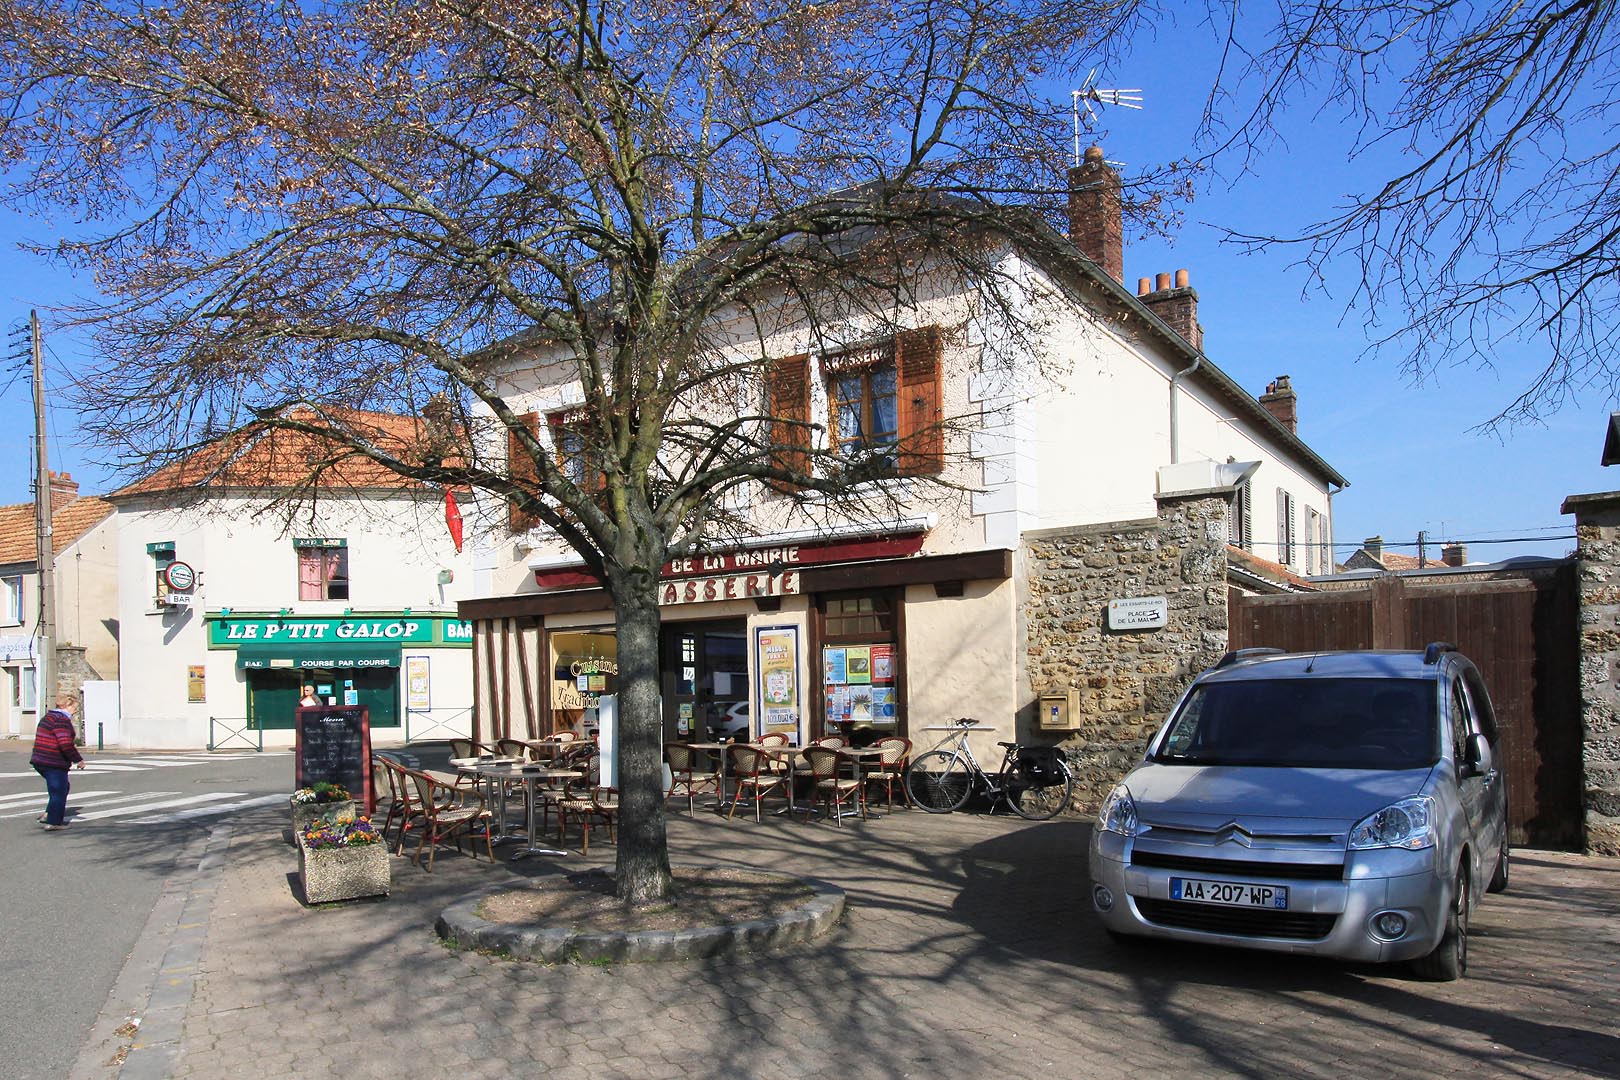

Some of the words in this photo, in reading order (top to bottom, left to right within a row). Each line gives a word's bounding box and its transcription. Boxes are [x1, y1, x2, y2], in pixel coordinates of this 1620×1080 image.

[671, 559, 694, 573] DE
[703, 555, 726, 570] LA
[734, 546, 800, 567] MAIRIE
[664, 571, 796, 602] ASSERIE
[173, 595, 190, 603] BAR
[227, 623, 258, 640] LE
[263, 623, 329, 640] P'TIT
[336, 622, 419, 639] GALOP
[447, 623, 473, 638] BAR
[338, 659, 354, 667] PAR
[570, 655, 619, 676] Cuisine
[558, 687, 600, 709] Traditio
[1183, 881, 1273, 905] AA-207-WP
[1275, 898, 1286, 907] 28
